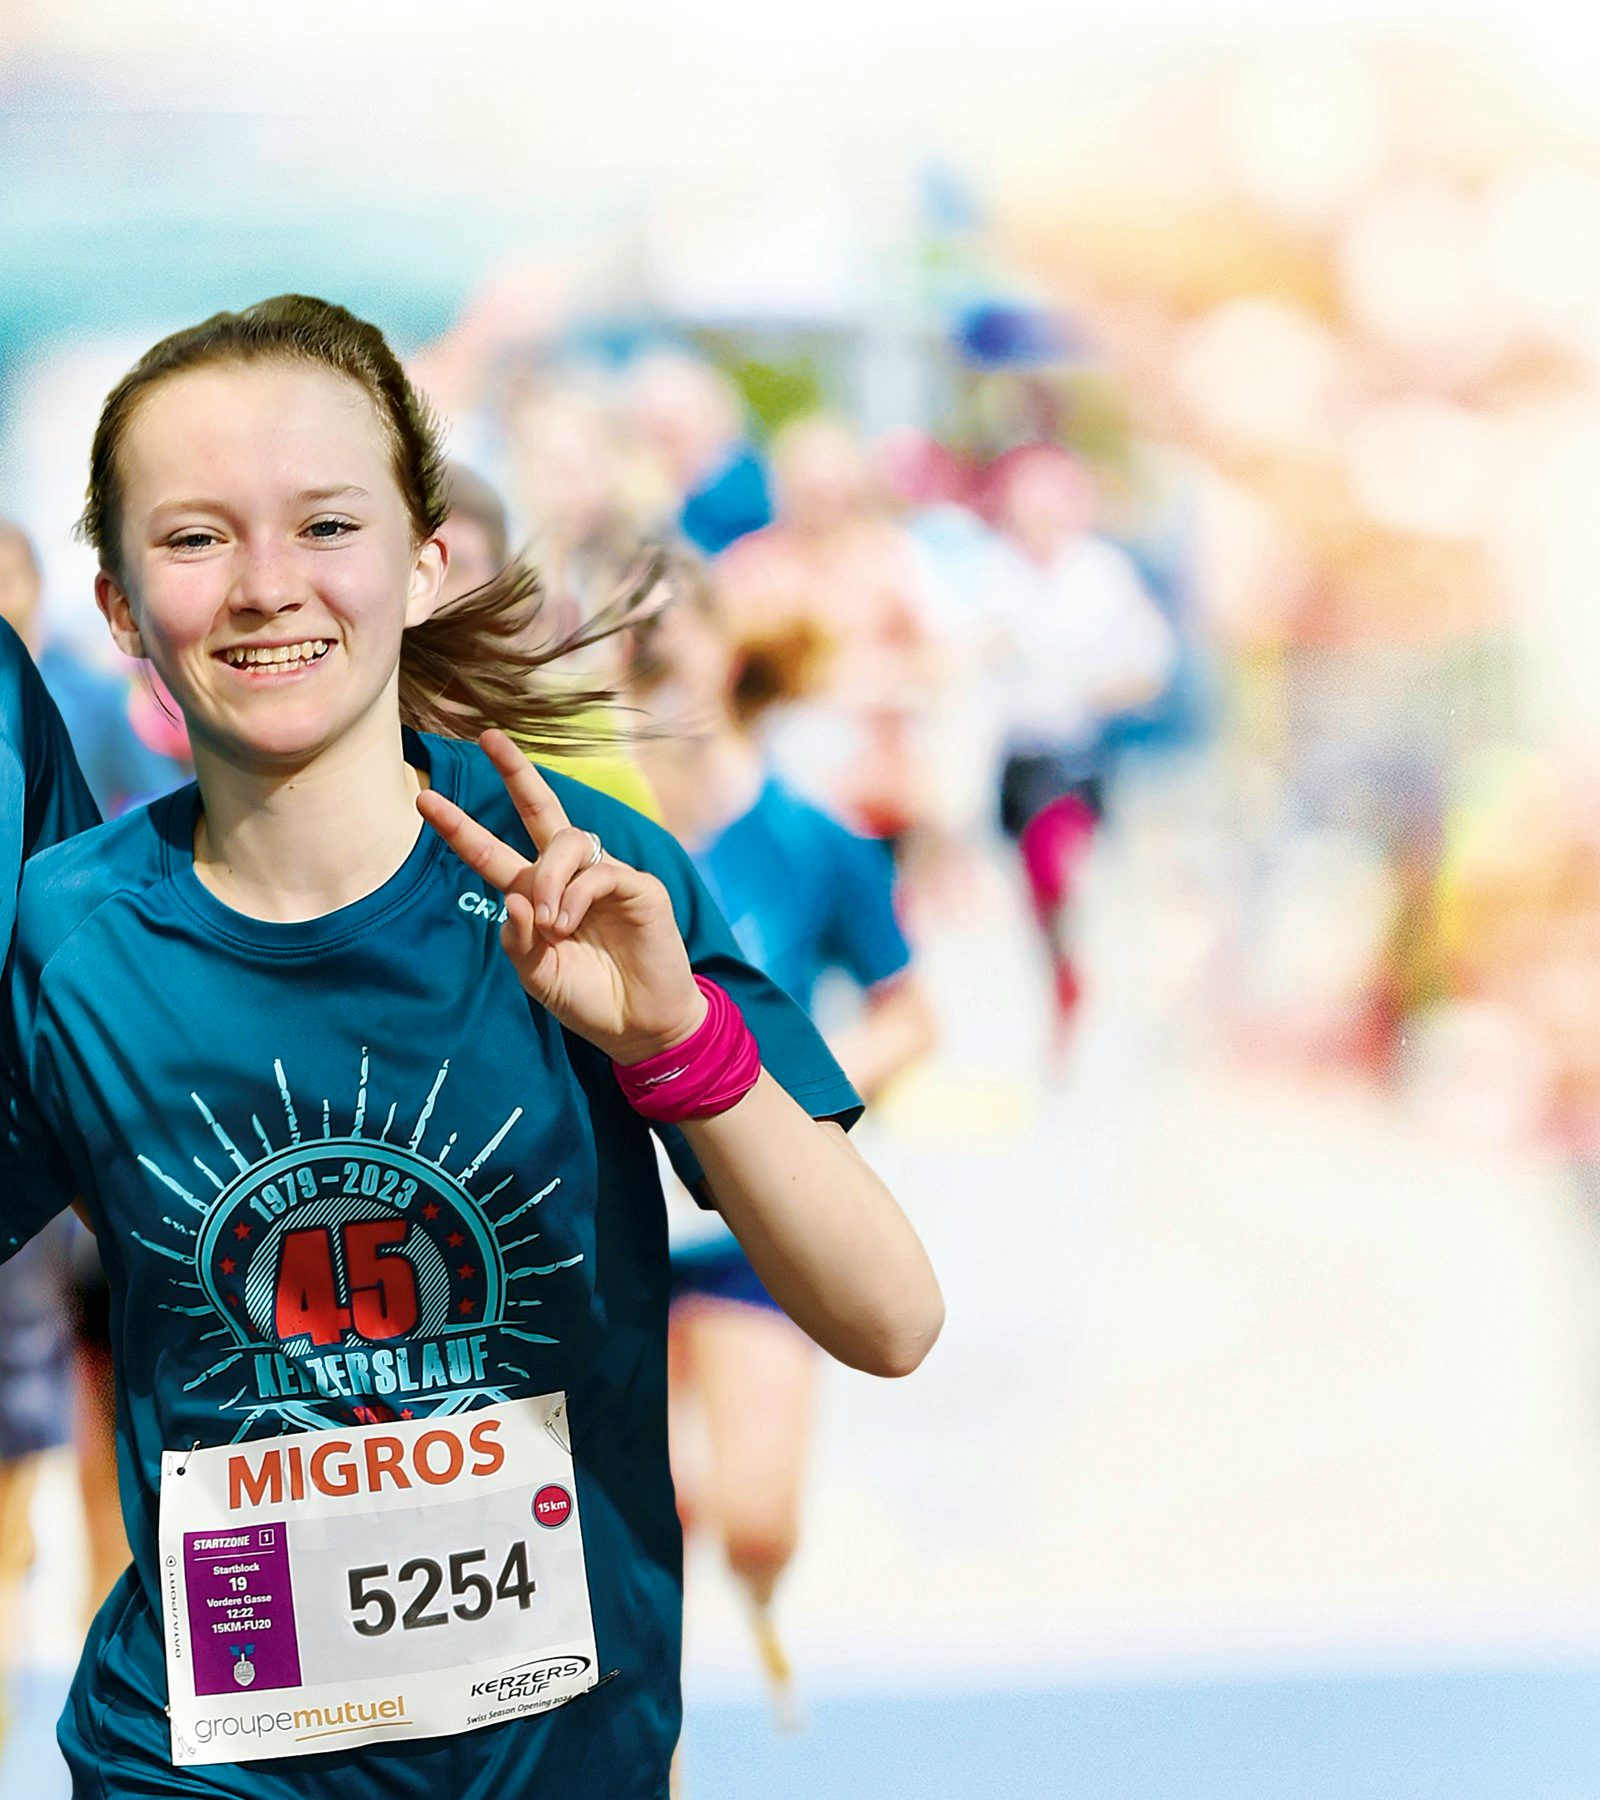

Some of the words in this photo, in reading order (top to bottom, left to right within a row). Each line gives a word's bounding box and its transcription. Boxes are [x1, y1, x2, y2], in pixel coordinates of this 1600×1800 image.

[274, 1219, 419, 1346] 45
[228, 1419, 505, 1510] MIGROS
[193, 1535, 250, 1550] STARTZONE
[213, 1562, 260, 1575] Startblock
[228, 1577, 248, 1592] 19
[347, 1541, 536, 1638] 5254
[206, 1596, 242, 1608] Vordere
[243, 1594, 272, 1605] Gasse
[226, 1607, 254, 1619] 12:22
[211, 1619, 272, 1634] 15KM-FU20
[470, 1662, 578, 1697] KERZERS
[497, 1682, 550, 1702] LAUF
[194, 1695, 406, 1743] groupemutuel
[466, 1714, 487, 1725] Swiss
[488, 1707, 516, 1720] Season
[517, 1700, 552, 1712] Opening
